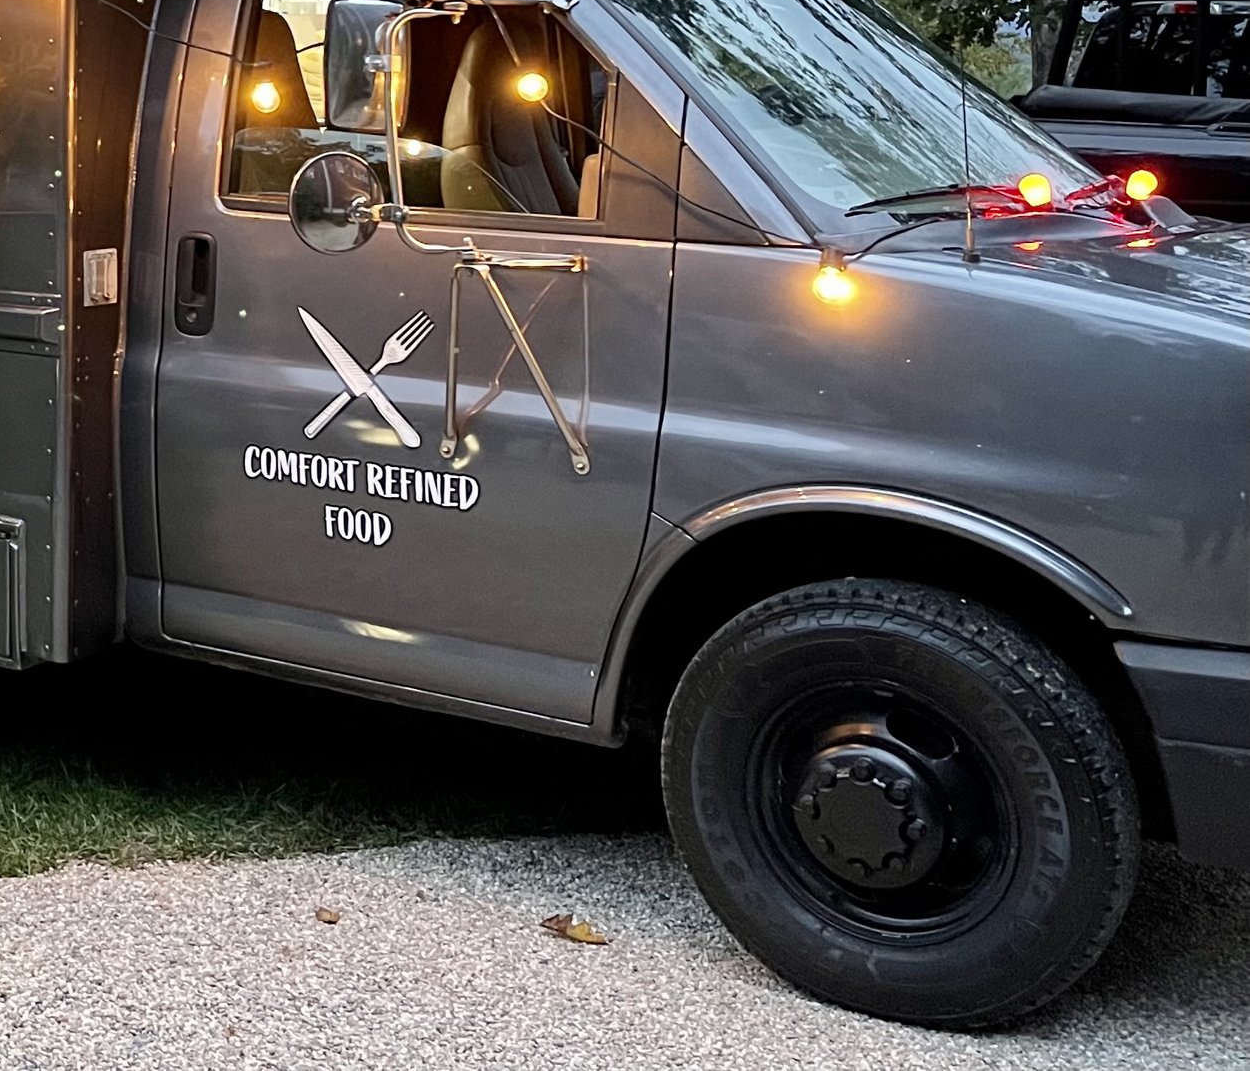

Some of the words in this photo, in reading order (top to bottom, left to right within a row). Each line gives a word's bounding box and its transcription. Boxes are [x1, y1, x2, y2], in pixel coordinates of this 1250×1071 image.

[244, 445, 359, 492] COMFORT
[366, 461, 479, 510] REFINED
[324, 505, 392, 545] FOOD
